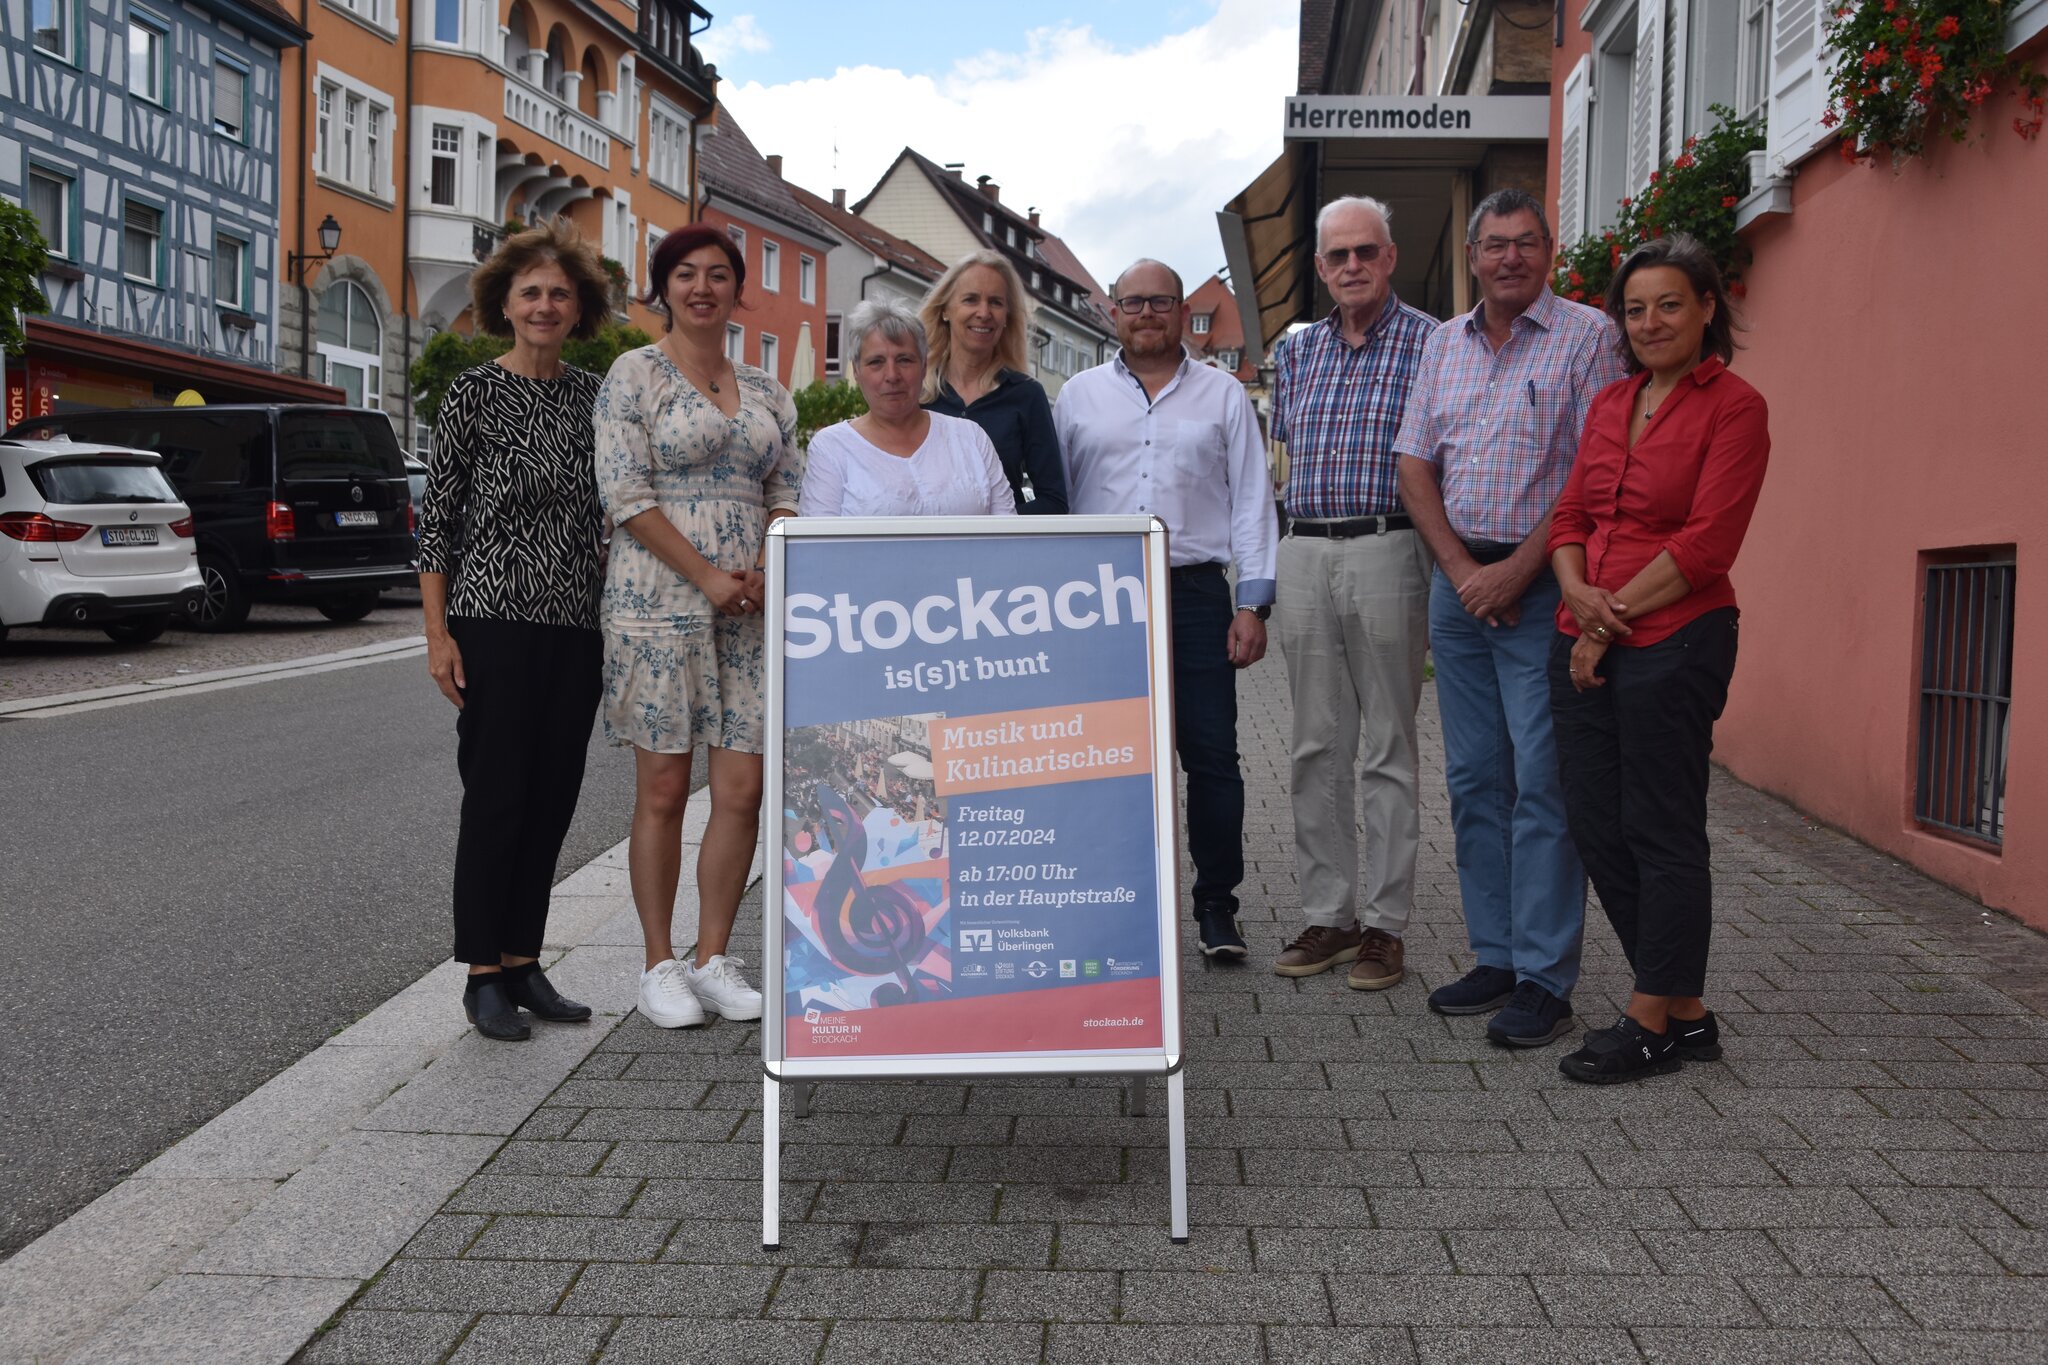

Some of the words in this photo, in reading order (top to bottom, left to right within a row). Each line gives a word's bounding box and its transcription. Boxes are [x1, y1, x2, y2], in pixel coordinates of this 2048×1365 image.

[1288, 102, 1471, 129] Herrenmoden
[108, 529, 125, 542] STO
[129, 529, 140, 541] CL
[142, 528, 156, 541] 119
[784, 563, 1147, 660] Stockach
[884, 659, 970, 692] is(s)t
[975, 651, 1050, 681] bunt
[942, 721, 1026, 751] Musik
[1031, 714, 1084, 741] und
[945, 745, 1135, 783] Kulinarisches
[957, 806, 1025, 825] Freitag
[957, 829, 1056, 847] 12.07.2024
[959, 866, 982, 882] ab
[986, 865, 1037, 882] 17:00
[1041, 864, 1078, 881] Uhr
[960, 891, 979, 907] in
[983, 890, 1016, 906] der
[1017, 887, 1136, 908] Hauptstraße
[997, 928, 1050, 939] Volksbank
[997, 940, 1055, 953] Überlingen
[812, 1026, 849, 1034] KULTUR
[851, 1025, 861, 1033] IN
[820, 1016, 847, 1025] MEINE
[1083, 1016, 1144, 1027] stockach.de
[812, 1035, 858, 1044] STOCKACH
